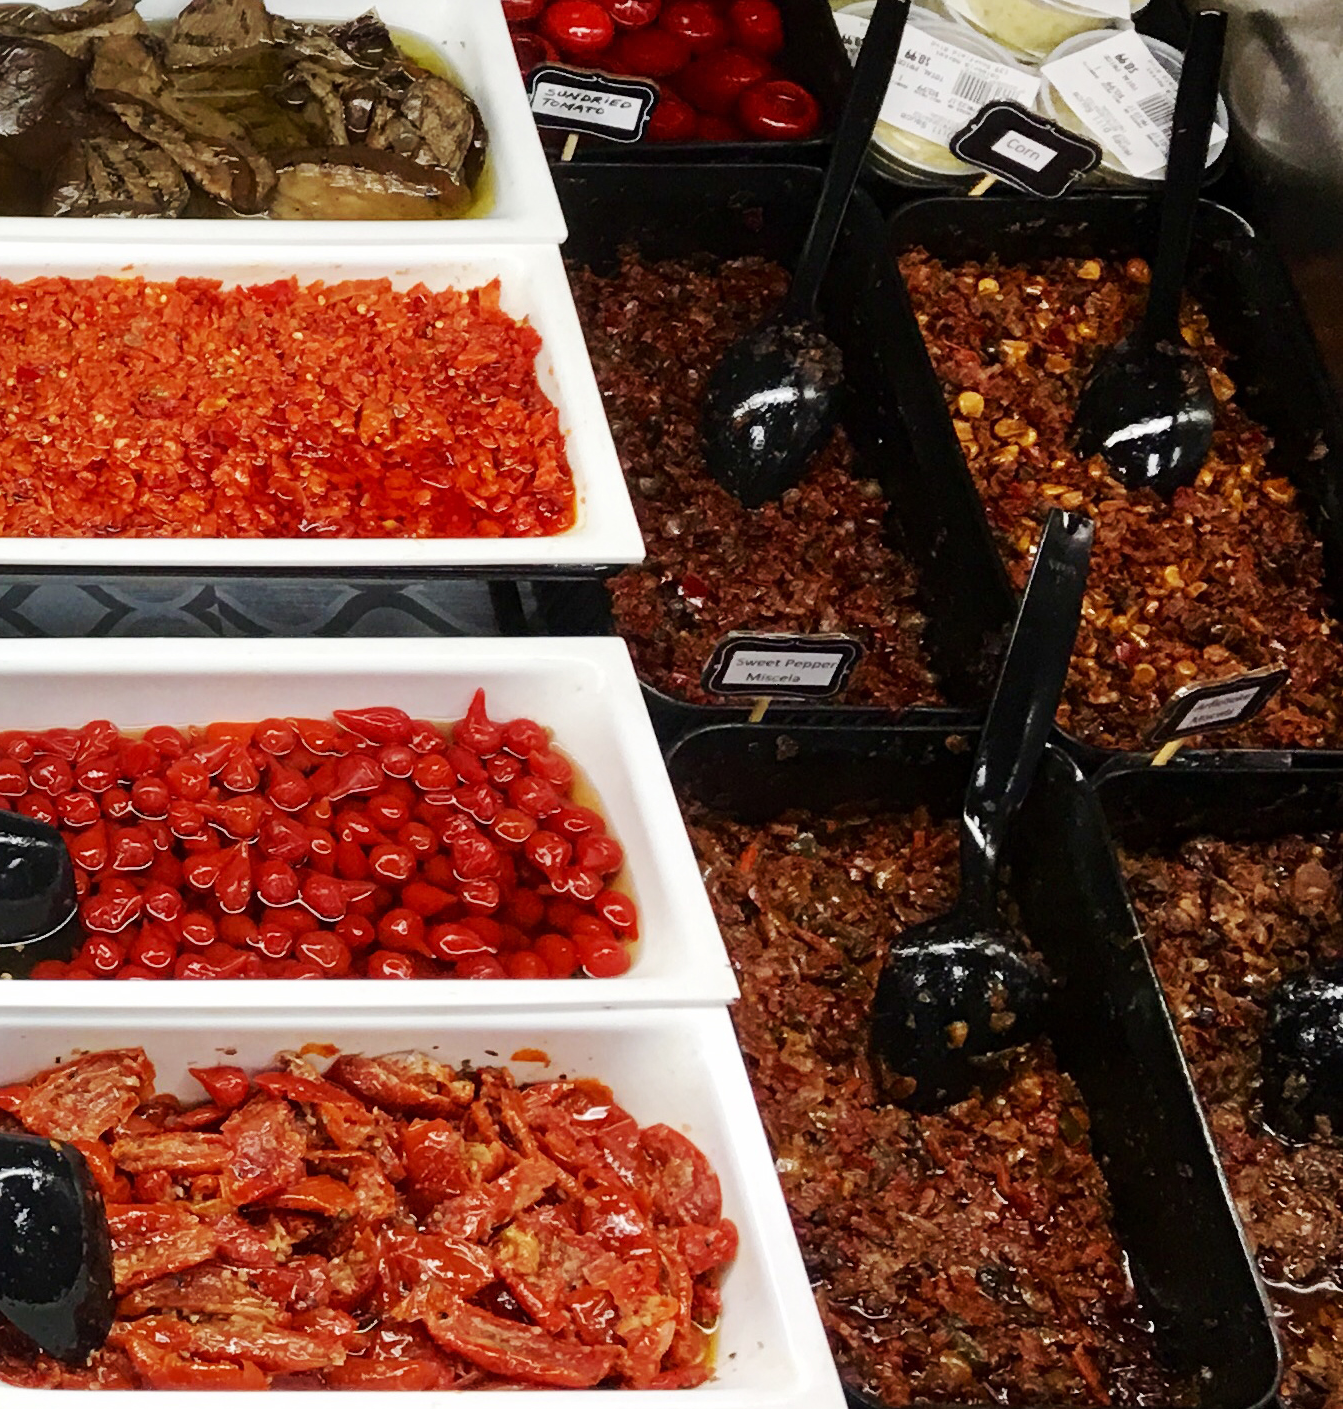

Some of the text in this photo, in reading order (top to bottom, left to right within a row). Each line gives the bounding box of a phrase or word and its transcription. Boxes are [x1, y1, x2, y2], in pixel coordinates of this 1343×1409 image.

[543, 97, 605, 115] TOMATO
[545, 88, 632, 108] SUNDRIED
[1006, 138, 1040, 160] Corn
[736, 657, 836, 669] Sweet Pepper
